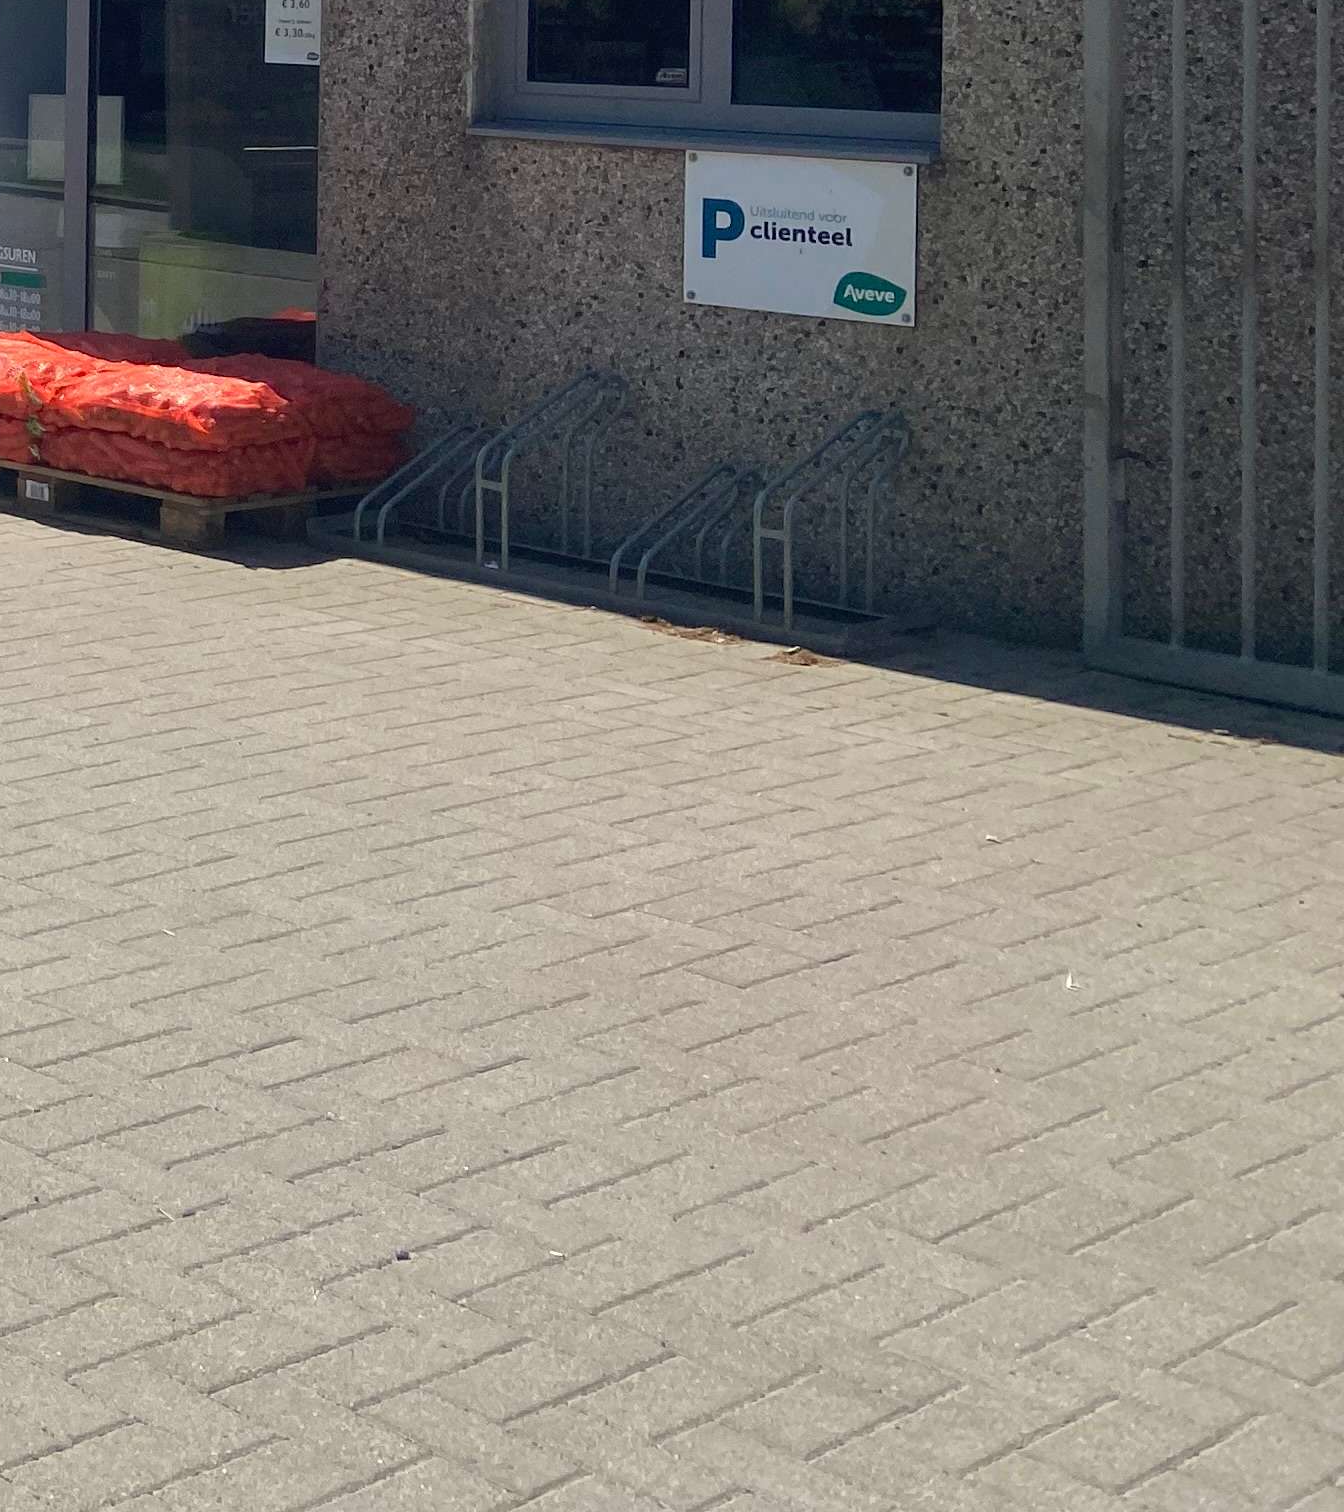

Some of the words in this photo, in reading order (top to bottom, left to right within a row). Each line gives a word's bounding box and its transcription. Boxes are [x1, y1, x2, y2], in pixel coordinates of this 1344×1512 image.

[750, 205, 816, 222] Uitsluitend
[818, 211, 848, 223] voor
[701, 197, 746, 259] P
[750, 221, 853, 247] clienteel
[843, 284, 895, 303] Aveve
